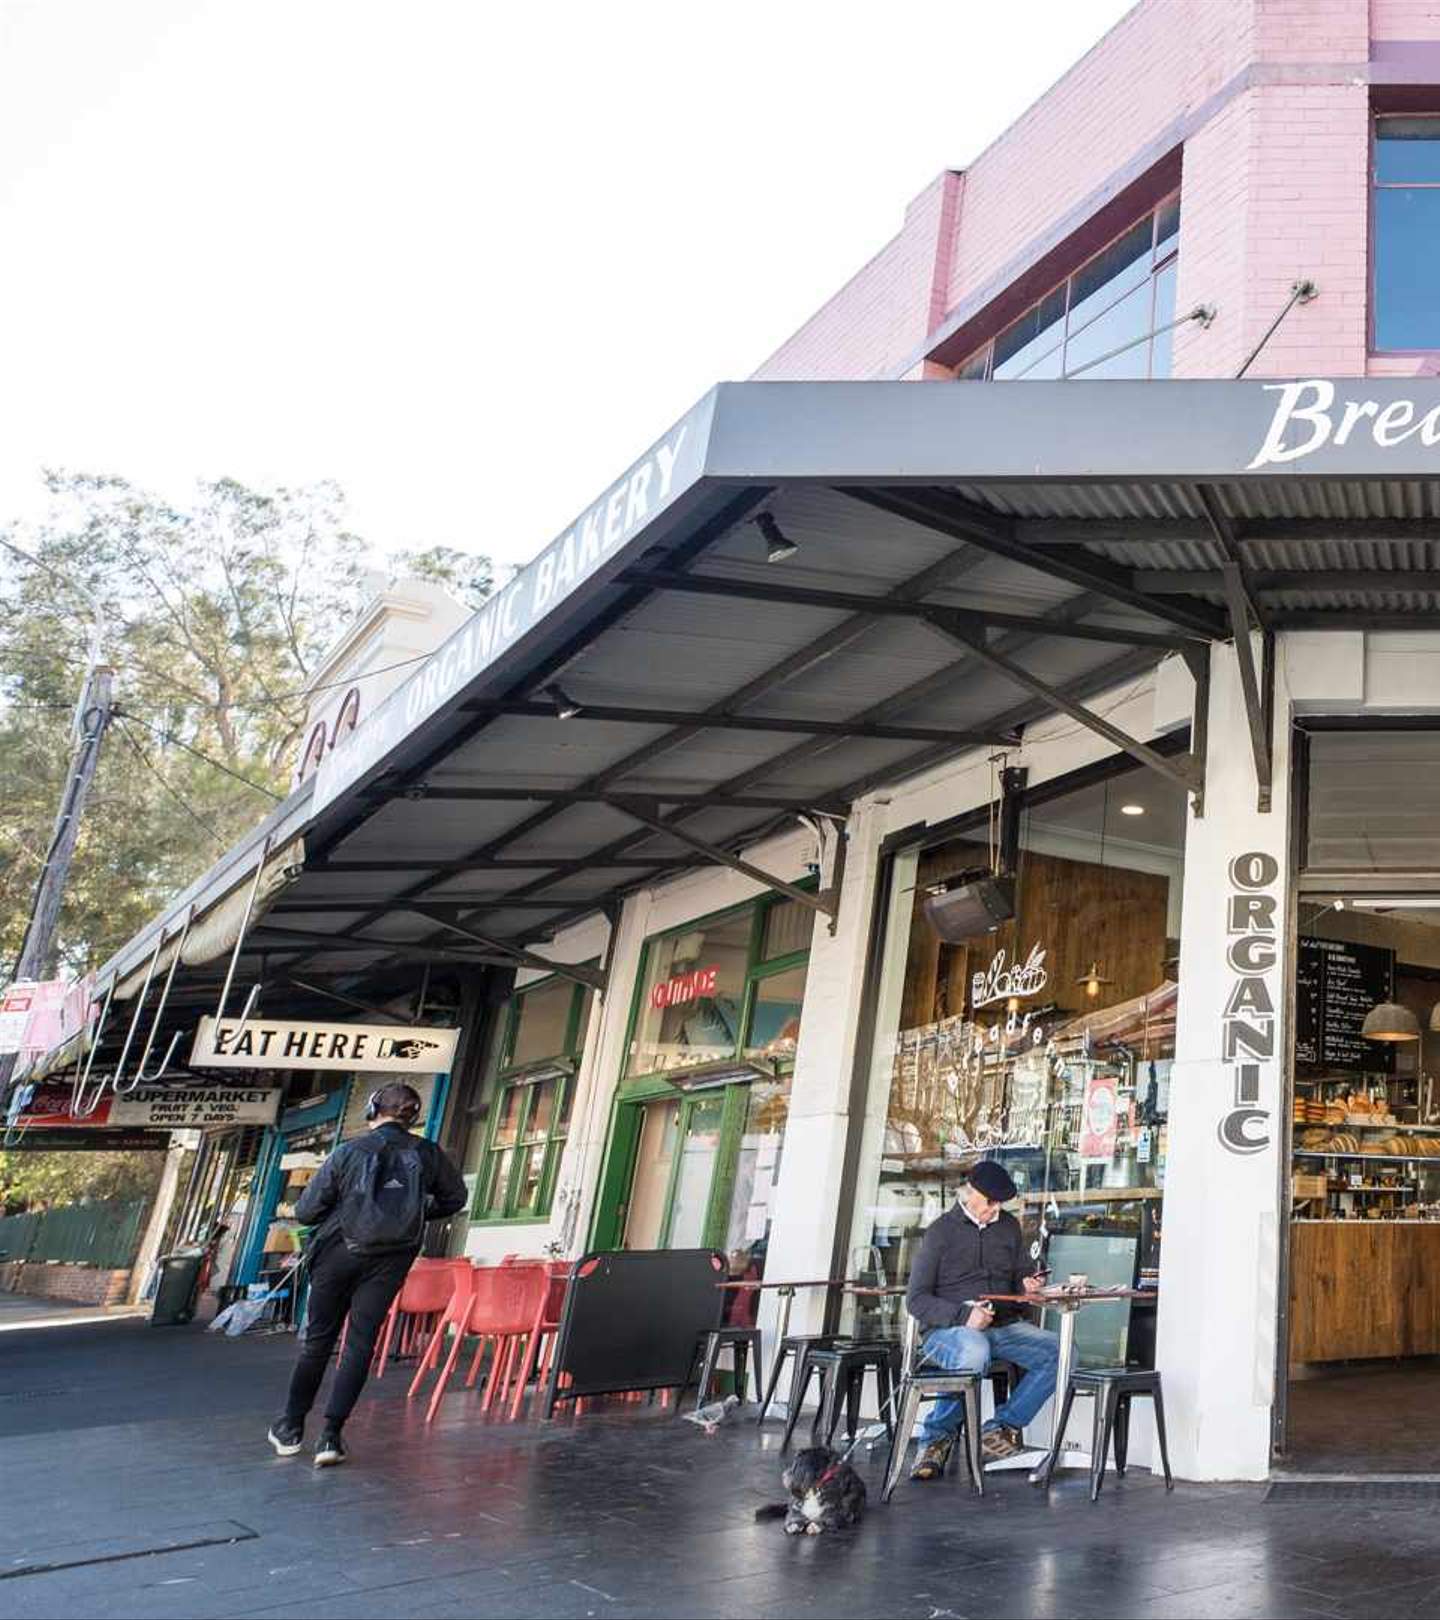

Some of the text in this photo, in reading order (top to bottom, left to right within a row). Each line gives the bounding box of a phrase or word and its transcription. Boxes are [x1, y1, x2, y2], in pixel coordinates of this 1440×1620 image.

[405, 426, 688, 721] ORGANIC BAKERY
[1217, 851, 1279, 1155] ORGANIC
[213, 1029, 369, 1059] EAT HERE
[120, 1090, 272, 1103] SUPERMARKET
[150, 1103, 189, 1112] FRUIT
[193, 1103, 204, 1112] &
[150, 1113, 236, 1122] OPEN 7 DAYS
